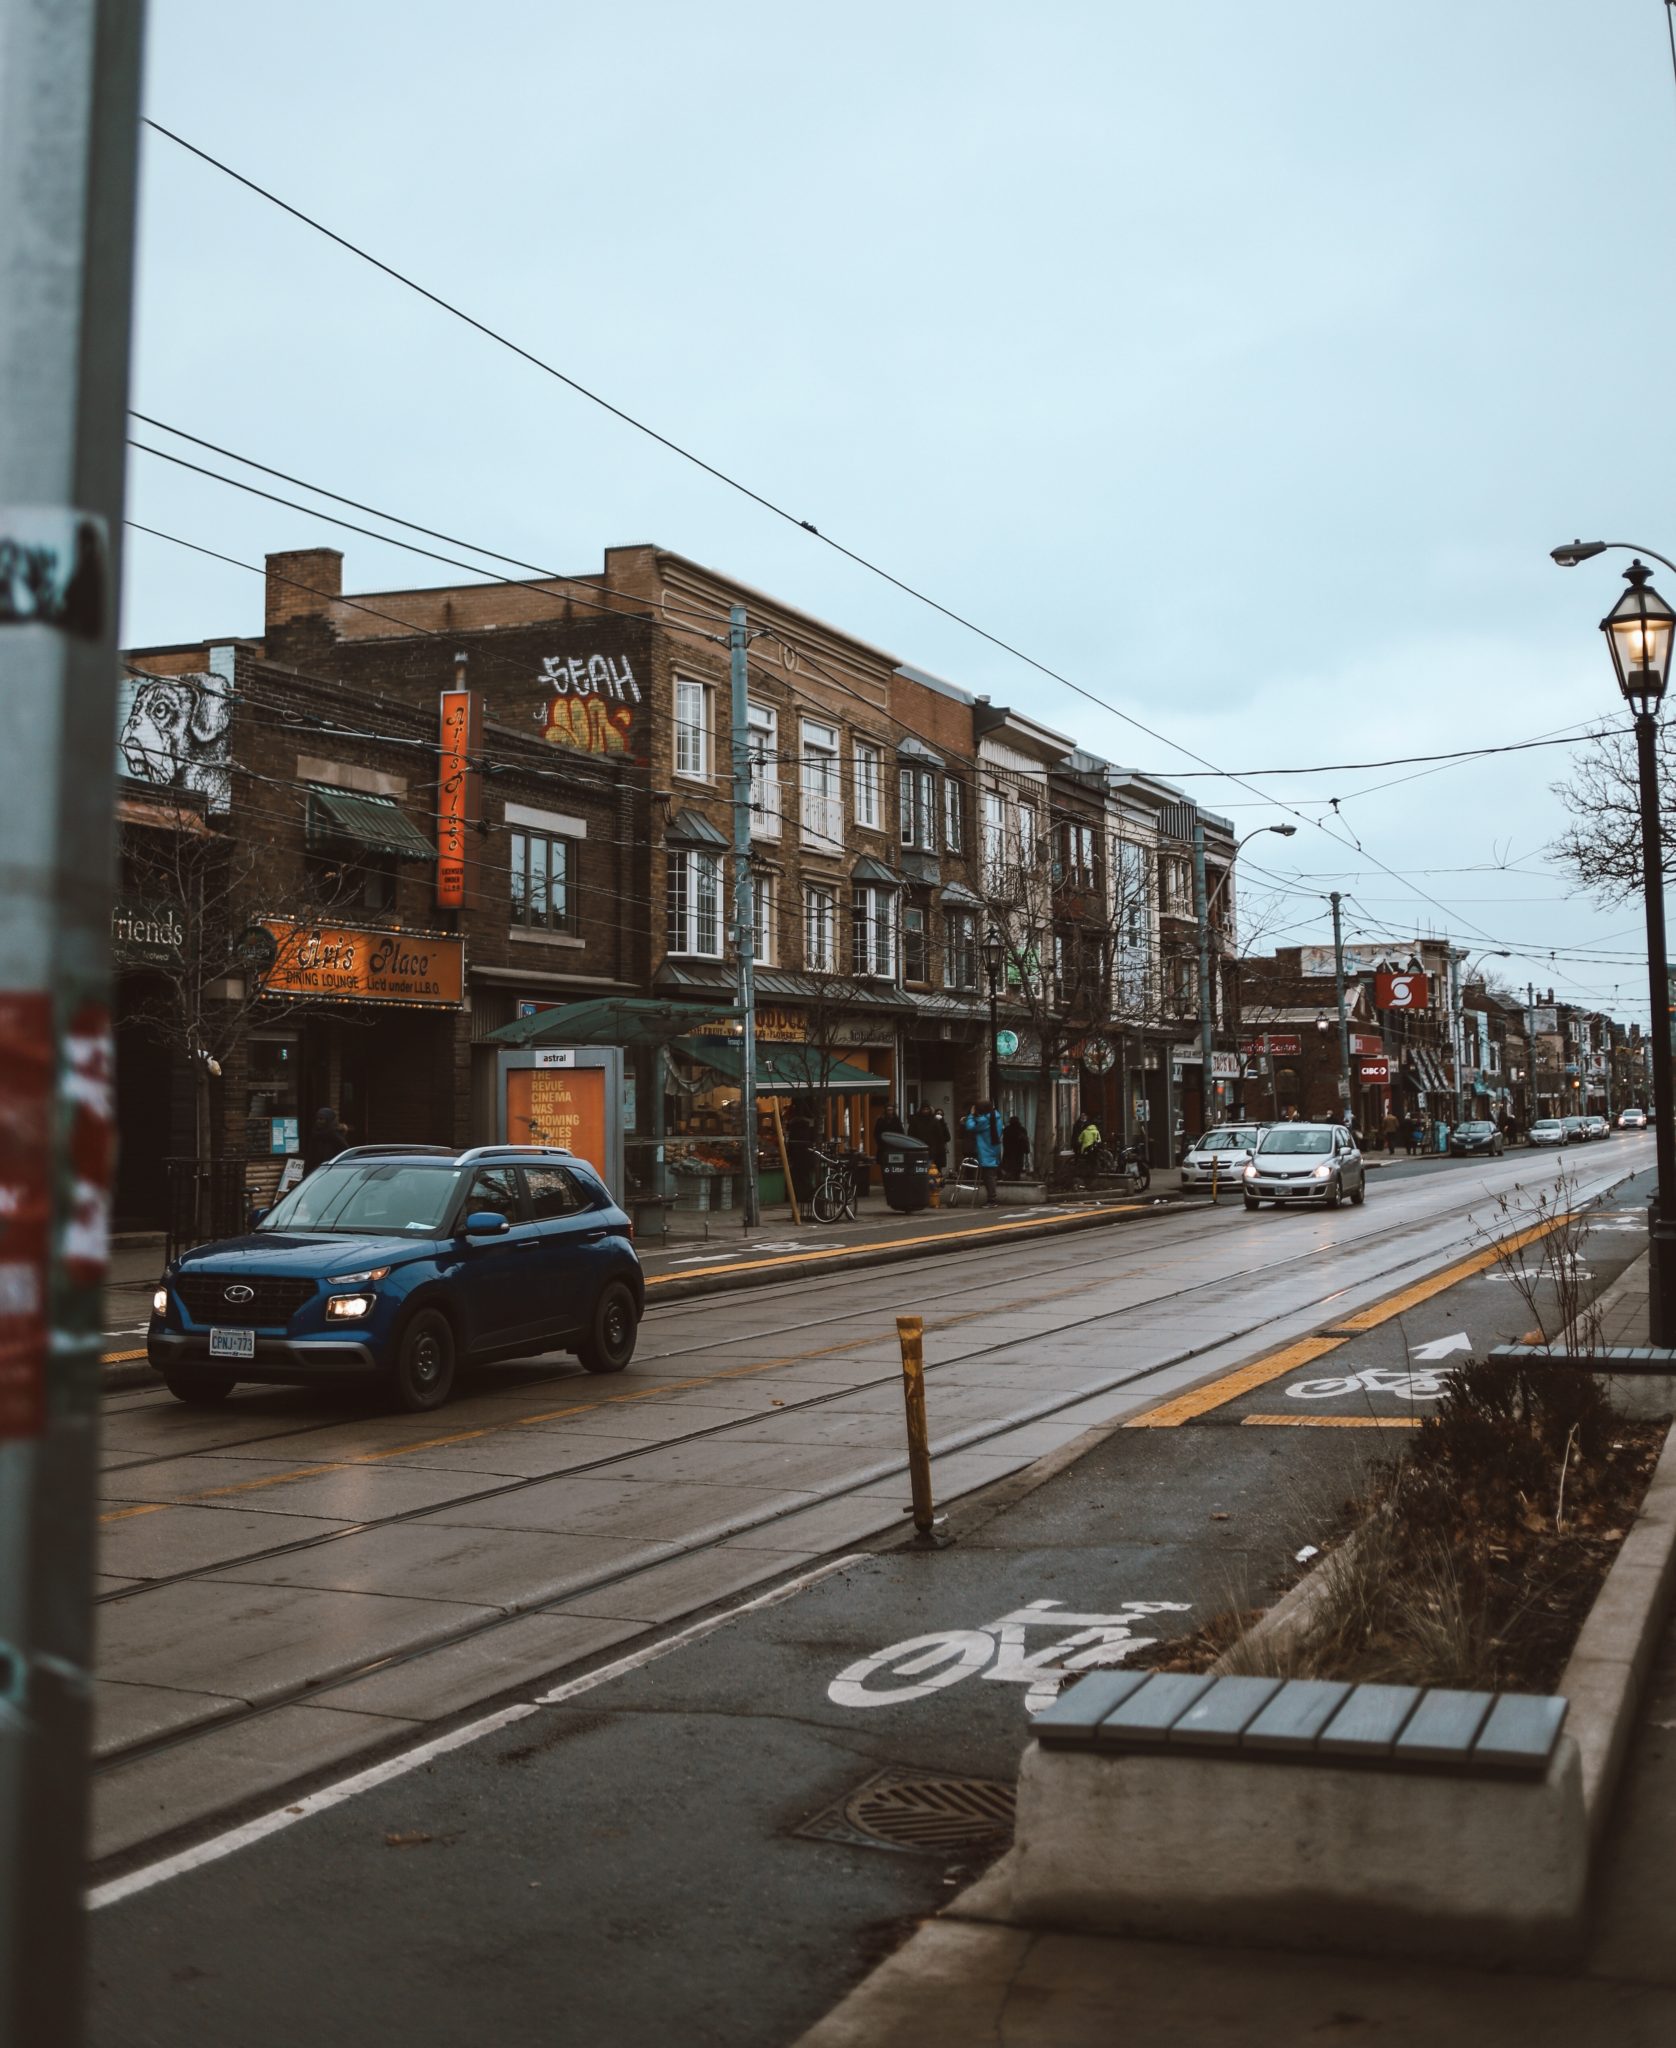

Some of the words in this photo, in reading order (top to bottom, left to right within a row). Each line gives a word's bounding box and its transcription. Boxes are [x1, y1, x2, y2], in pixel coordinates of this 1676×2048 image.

[286, 970, 319, 986] DINING
[321, 974, 360, 989] LOUNGE
[389, 981, 413, 993] under
[543, 1054, 567, 1062] astral
[532, 1071, 551, 1080] THE
[1361, 1066, 1379, 1075] CIBC
[532, 1081, 564, 1091] REVUE
[532, 1092, 572, 1102] CINEMA
[532, 1104, 553, 1114] WAS
